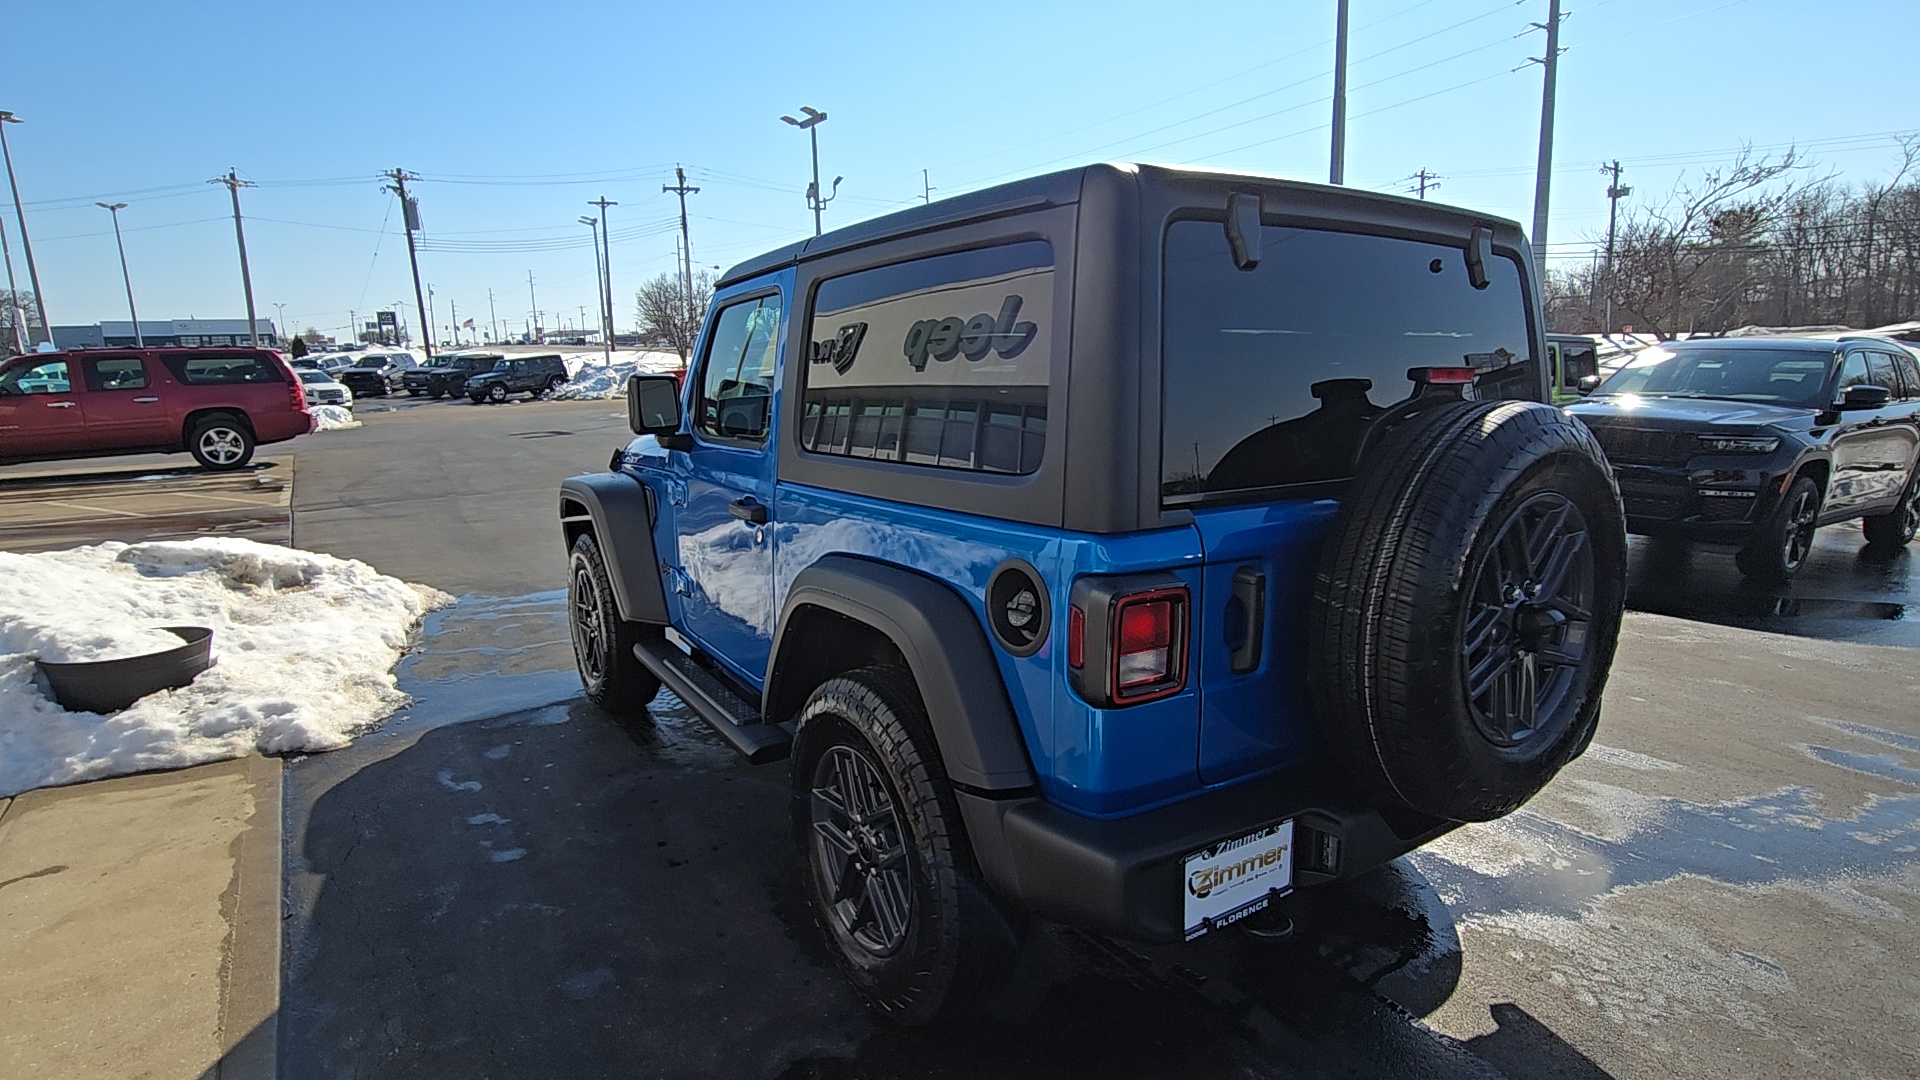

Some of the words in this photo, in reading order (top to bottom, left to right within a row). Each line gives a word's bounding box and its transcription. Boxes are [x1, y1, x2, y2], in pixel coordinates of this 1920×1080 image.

[1213, 828, 1270, 858] Zimmer
[1194, 843, 1288, 895] Zimmer
[1216, 899, 1269, 929] FLORENCE
